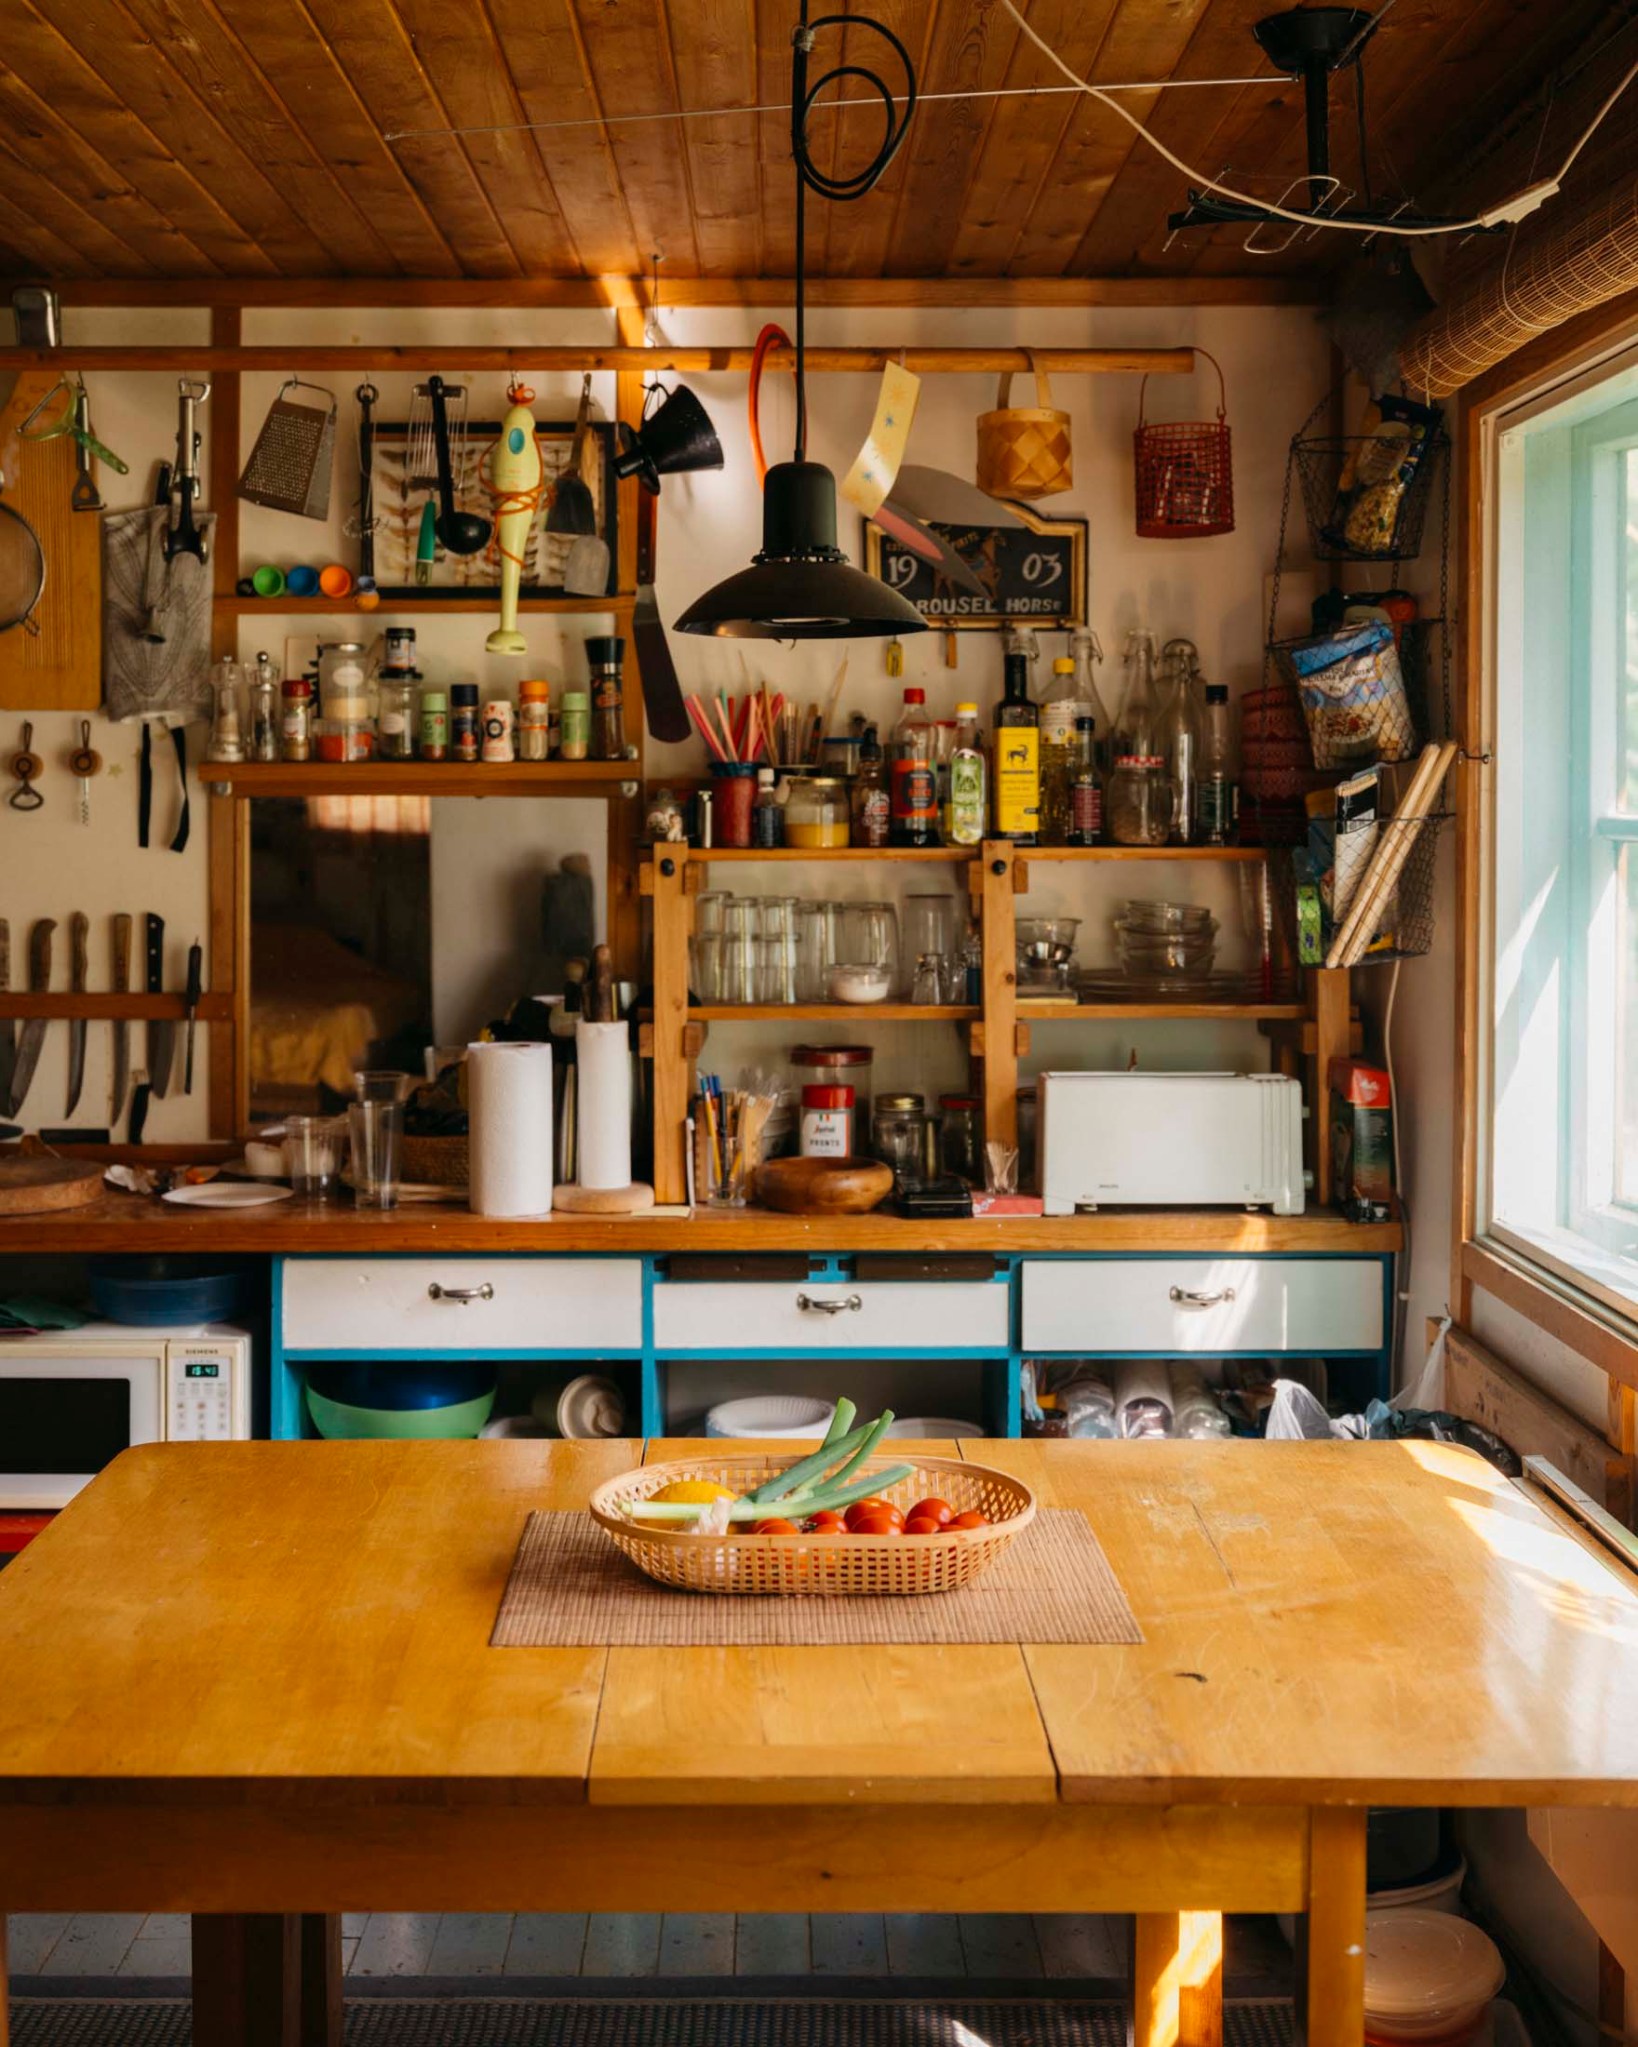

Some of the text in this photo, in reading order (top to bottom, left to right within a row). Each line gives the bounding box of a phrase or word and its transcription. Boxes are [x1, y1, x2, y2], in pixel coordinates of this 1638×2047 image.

[889, 552, 1063, 590] 19 03
[916, 596, 998, 614] ROUSEL
